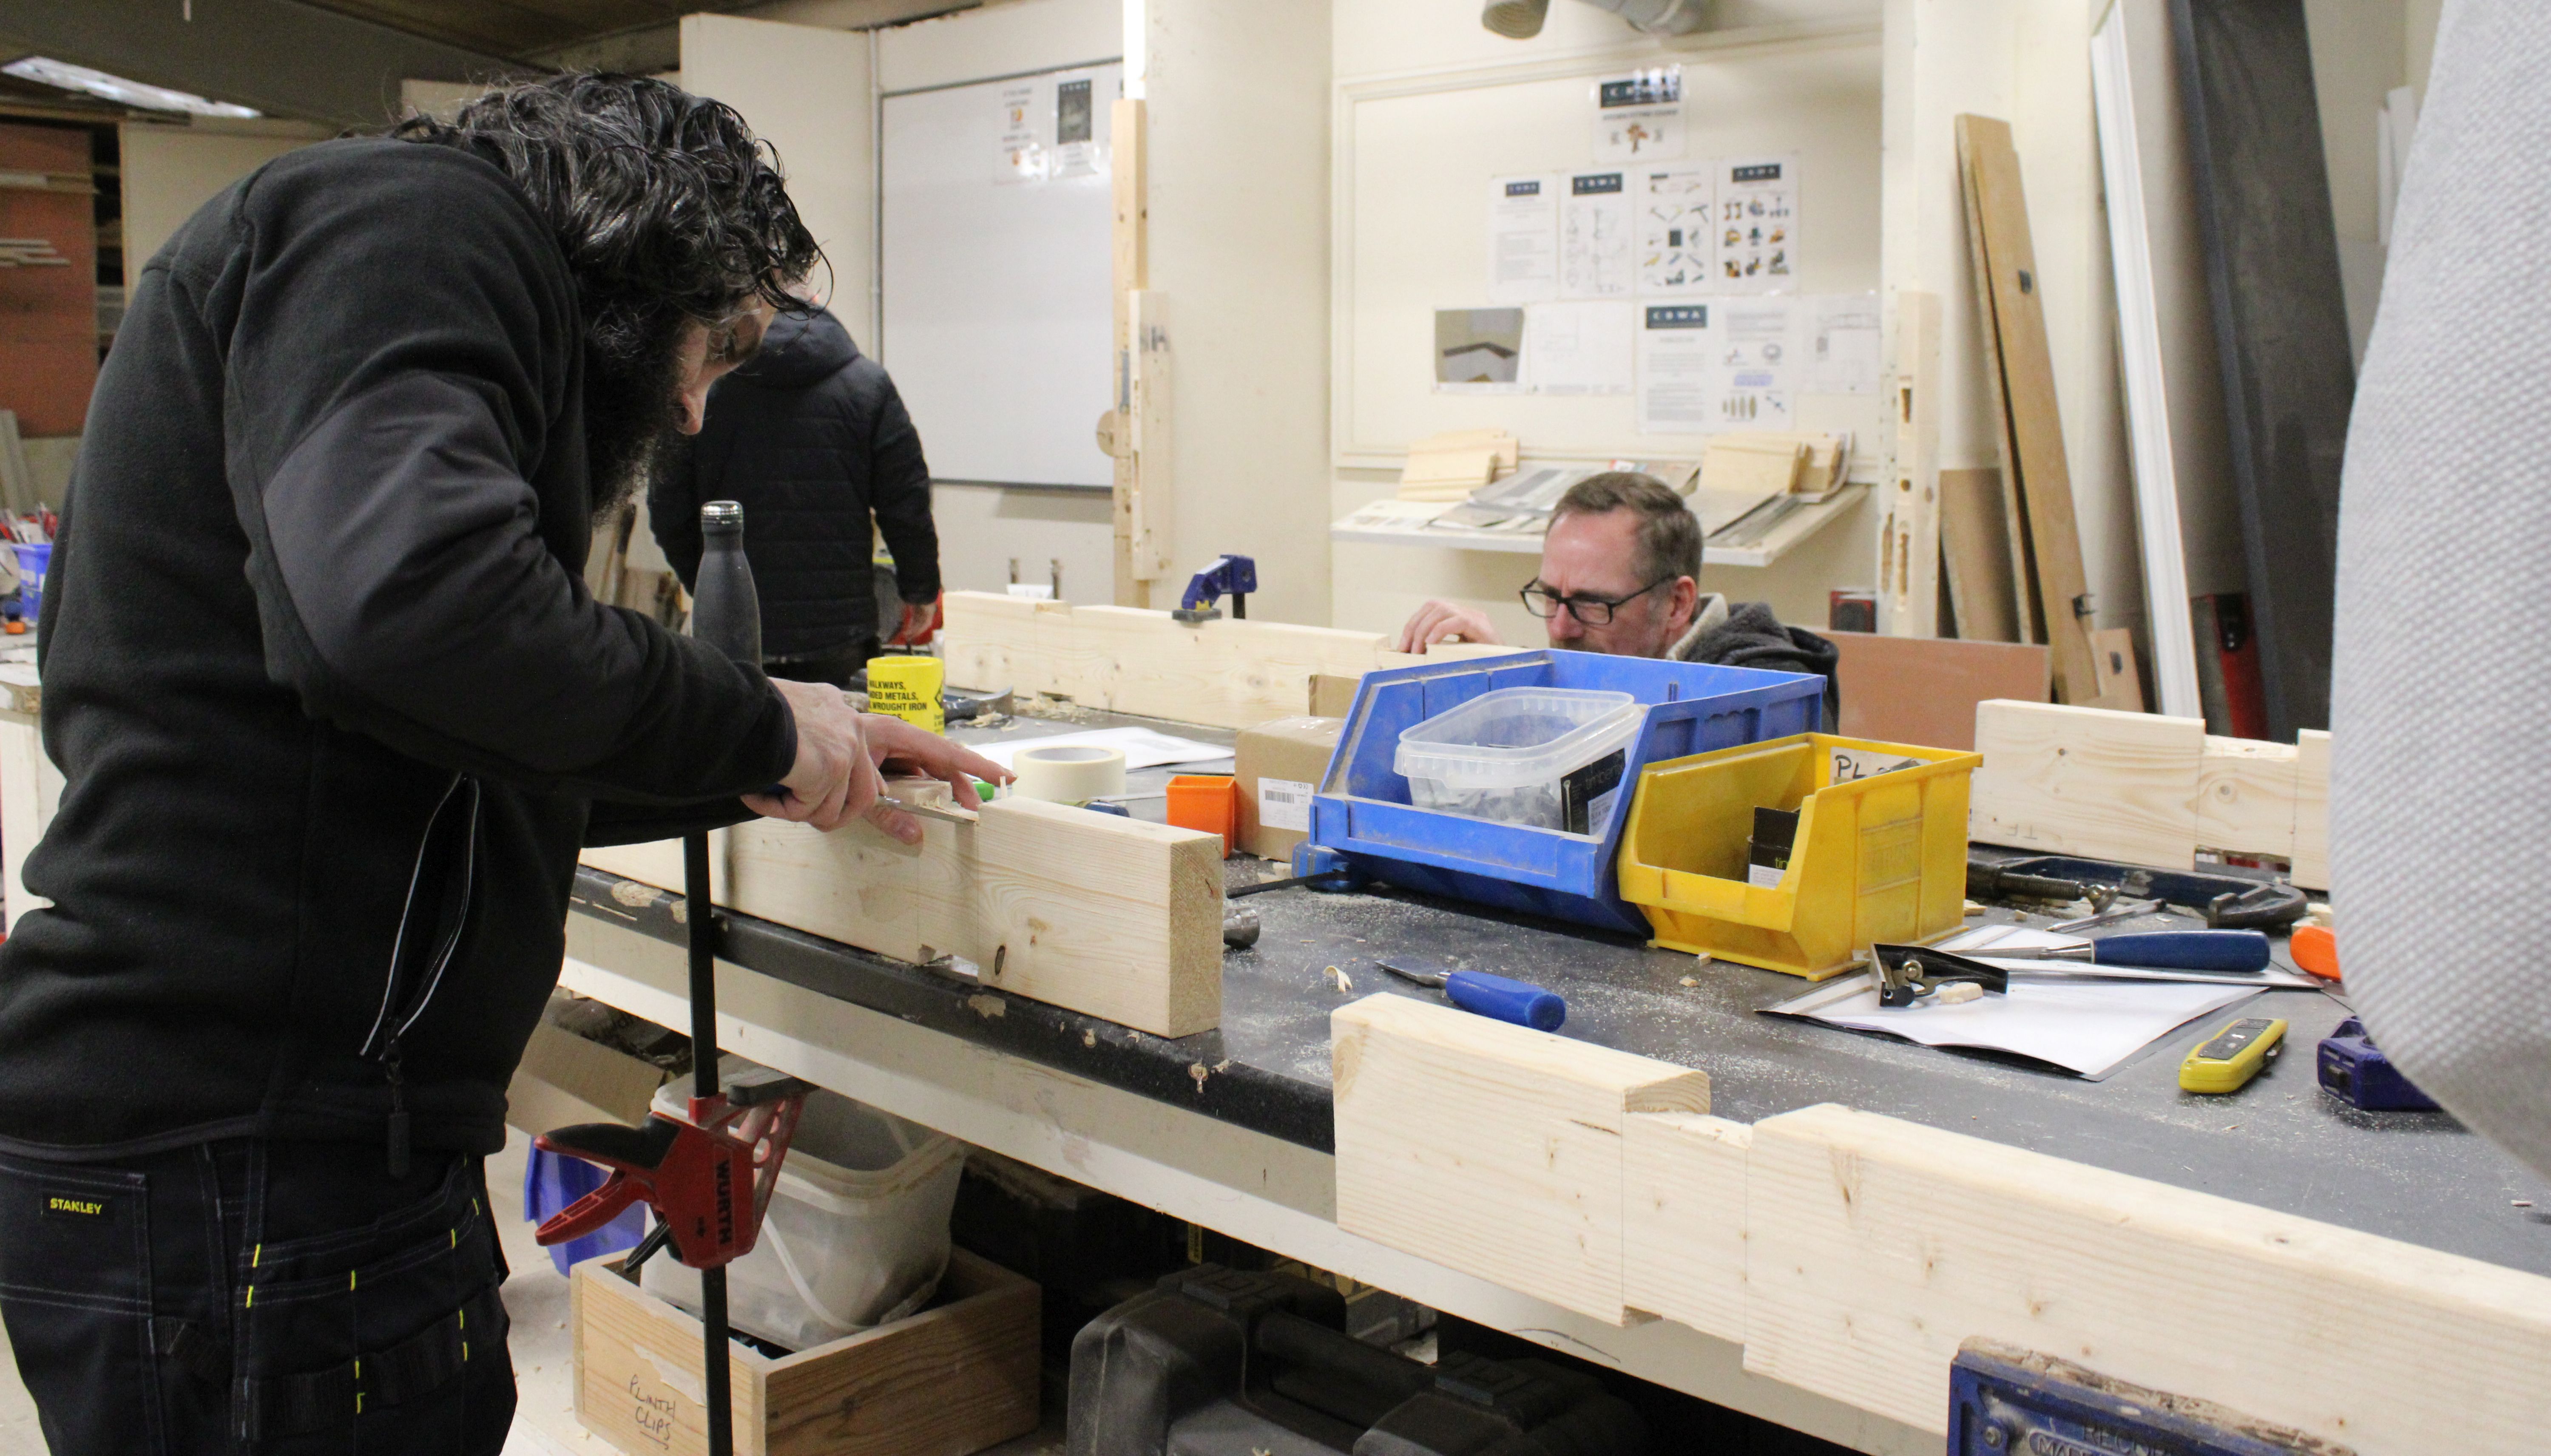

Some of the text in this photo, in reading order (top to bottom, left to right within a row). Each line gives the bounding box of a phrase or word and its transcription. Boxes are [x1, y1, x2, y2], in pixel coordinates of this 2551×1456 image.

[885, 692, 918, 701] METALS,
[872, 702, 927, 711] WROUGHT IRON
[50, 1198, 102, 1215] STANLEY
[630, 1374, 675, 1422] PLINTH
[636, 1406, 671, 1440] CLIPS
